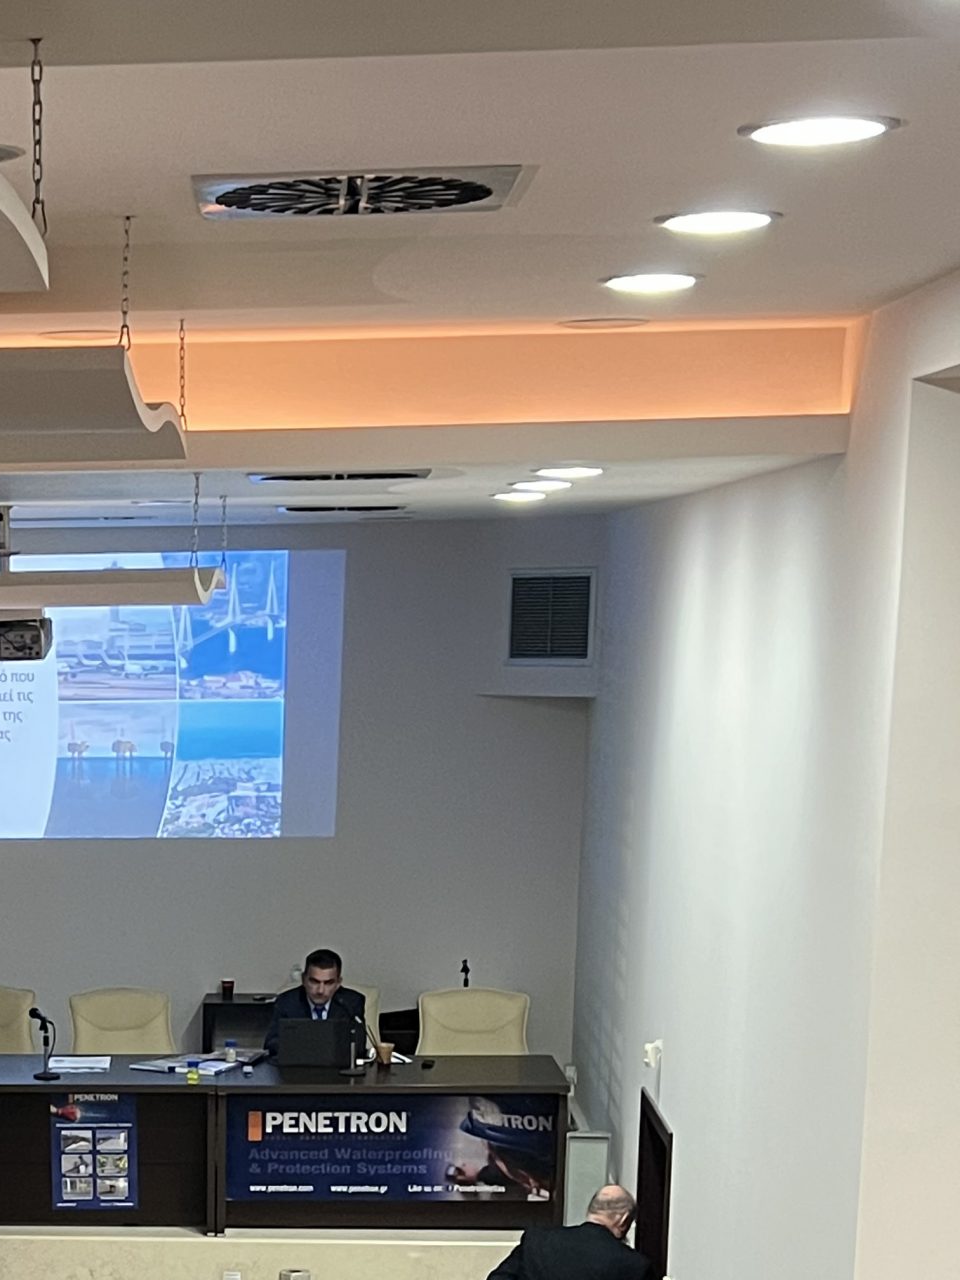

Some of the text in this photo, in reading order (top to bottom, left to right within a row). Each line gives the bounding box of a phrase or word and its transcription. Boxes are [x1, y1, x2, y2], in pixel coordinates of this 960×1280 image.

[10, 672, 35, 683] που
[16, 691, 34, 704] τις
[2, 711, 23, 723] της
[265, 1111, 407, 1133] PENETRON
[248, 1148, 454, 1163] Advanced Waterproofing
[248, 1162, 428, 1176] & Protection Systems
